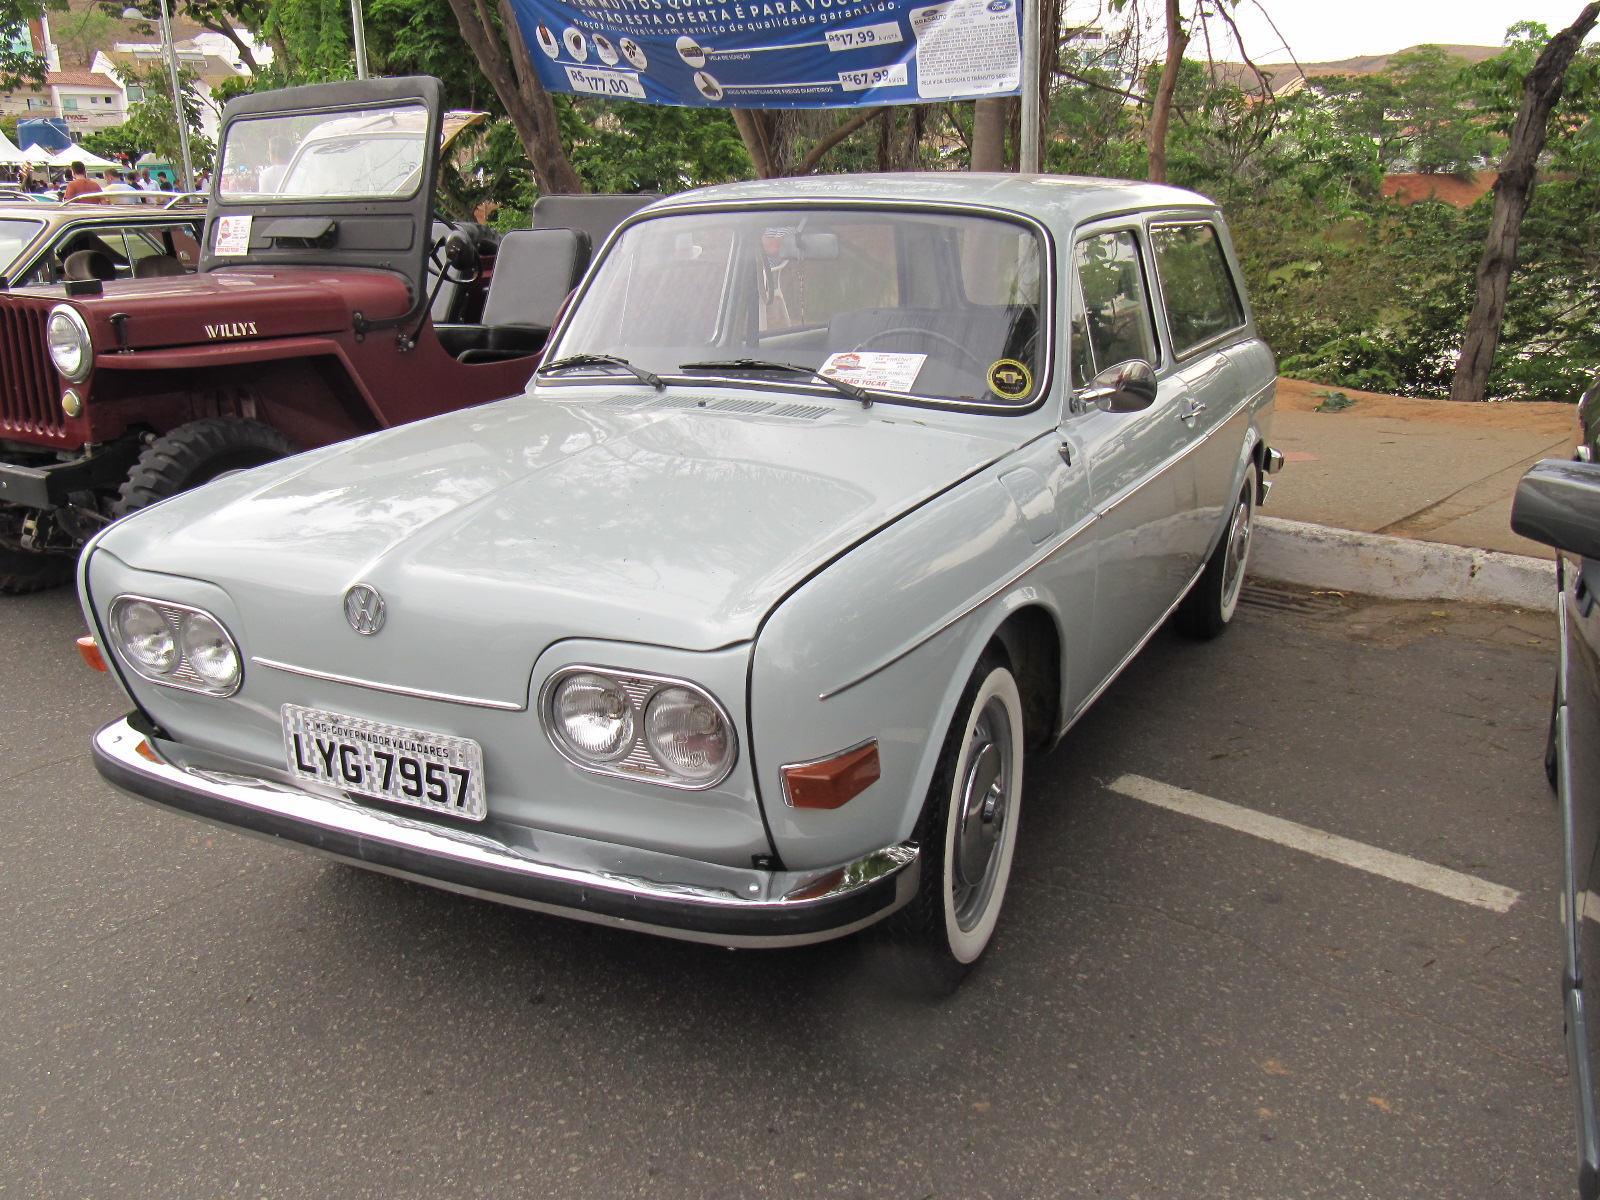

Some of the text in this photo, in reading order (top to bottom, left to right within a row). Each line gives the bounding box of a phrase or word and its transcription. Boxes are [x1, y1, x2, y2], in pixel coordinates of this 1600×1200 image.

[625, 14, 663, 25] ESTA
[665, 9, 731, 24] OFERTA
[735, 4, 745, 19] É
[750, 0, 801, 17] PARA
[682, 24, 726, 35] serviço
[729, 23, 744, 32] de
[747, 15, 816, 31] qualidade
[820, 1, 901, 23] garantido.
[204, 322, 258, 338] WILLYS
[861, 379, 887, 387] TOCAR
[391, 738, 449, 758] VALADARES
